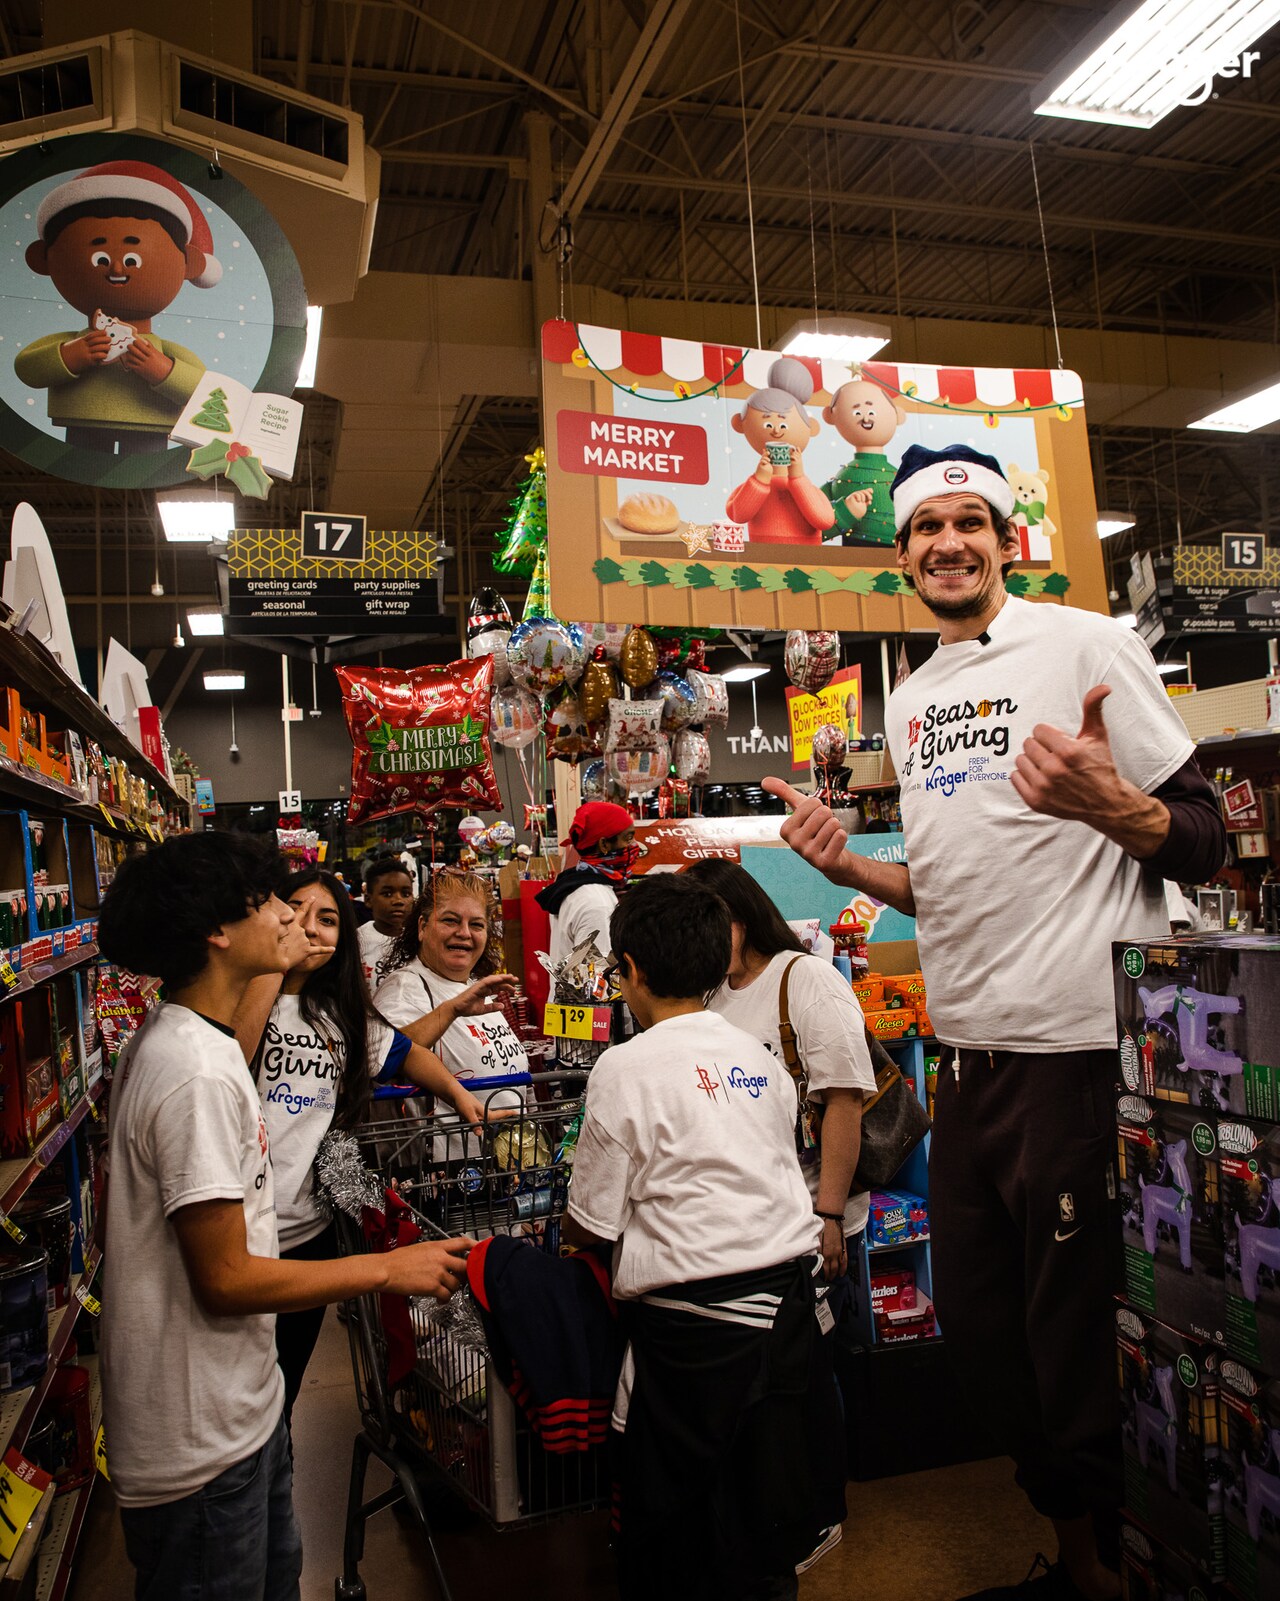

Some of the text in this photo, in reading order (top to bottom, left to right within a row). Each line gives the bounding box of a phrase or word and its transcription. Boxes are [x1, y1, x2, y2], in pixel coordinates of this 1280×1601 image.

[266, 404, 289, 416] Sugar
[262, 411, 289, 424] Cookie
[260, 418, 287, 431] Recipe
[590, 420, 676, 449] MERRY
[583, 445, 684, 475] MARKET
[314, 521, 353, 552] 17
[1230, 540, 1257, 565] 15
[247, 580, 318, 591] greeting cards
[354, 580, 421, 591] party supplies
[1186, 587, 1230, 597] flour & sugar
[262, 600, 307, 610] seasonal
[365, 599, 411, 611] gift wrap
[1219, 620, 1236, 628] pans
[1248, 620, 1268, 629] spices
[623, 708, 654, 717] GNOME
[793, 709, 841, 734] LOW PRICES
[402, 726, 458, 751] MERRY
[726, 735, 791, 754] THAN
[795, 738, 802, 747] on
[920, 723, 1010, 770] Giving
[379, 742, 478, 773] CHRISTMAS!
[902, 751, 915, 776] of
[968, 756, 990, 766] FRESH
[968, 765, 984, 774] FOR
[925, 765, 968, 797] Kroger
[281, 795, 300, 808] 15
[657, 826, 736, 838] HOLDAY
[685, 837, 722, 847] PET
[682, 848, 739, 860] GIFTS
[592, 1021, 608, 1029] SALE
[875, 1017, 905, 1030] Reese's
[481, 1050, 497, 1069] of
[1120, 1038, 1138, 1090] AIRBLOWN
[727, 1066, 768, 1099] Kroger
[266, 1082, 316, 1115] Kroger
[884, 1208, 903, 1220] JOLLY
[871, 1285, 898, 1299] izzlers
[15, 1460, 29, 1477] LOW
[22, 1466, 37, 1483] PRICE
